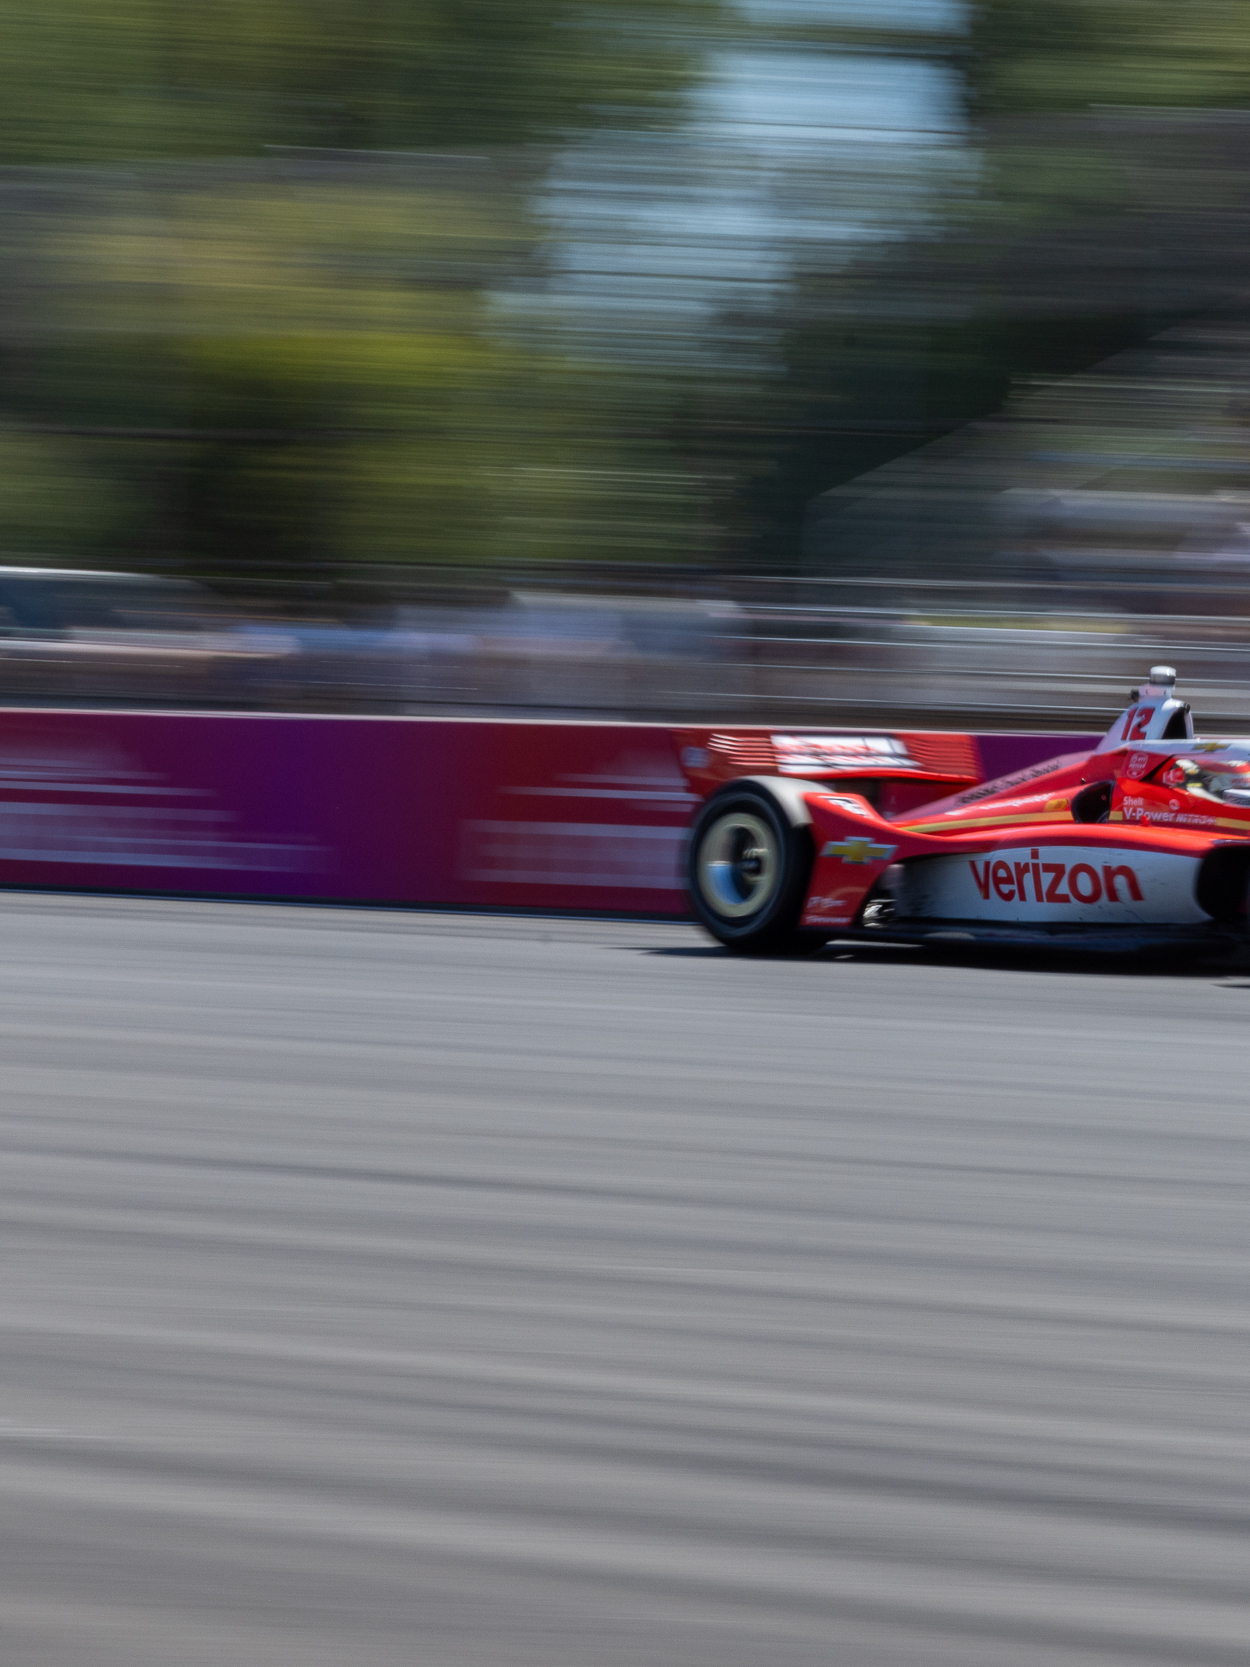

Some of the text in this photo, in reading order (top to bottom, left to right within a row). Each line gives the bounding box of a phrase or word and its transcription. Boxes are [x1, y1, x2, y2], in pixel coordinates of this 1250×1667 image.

[1121, 707, 1155, 741] 12
[1123, 796, 1143, 807] Shell
[1123, 807, 1174, 822] V-Power
[969, 848, 1145, 904] verizon
